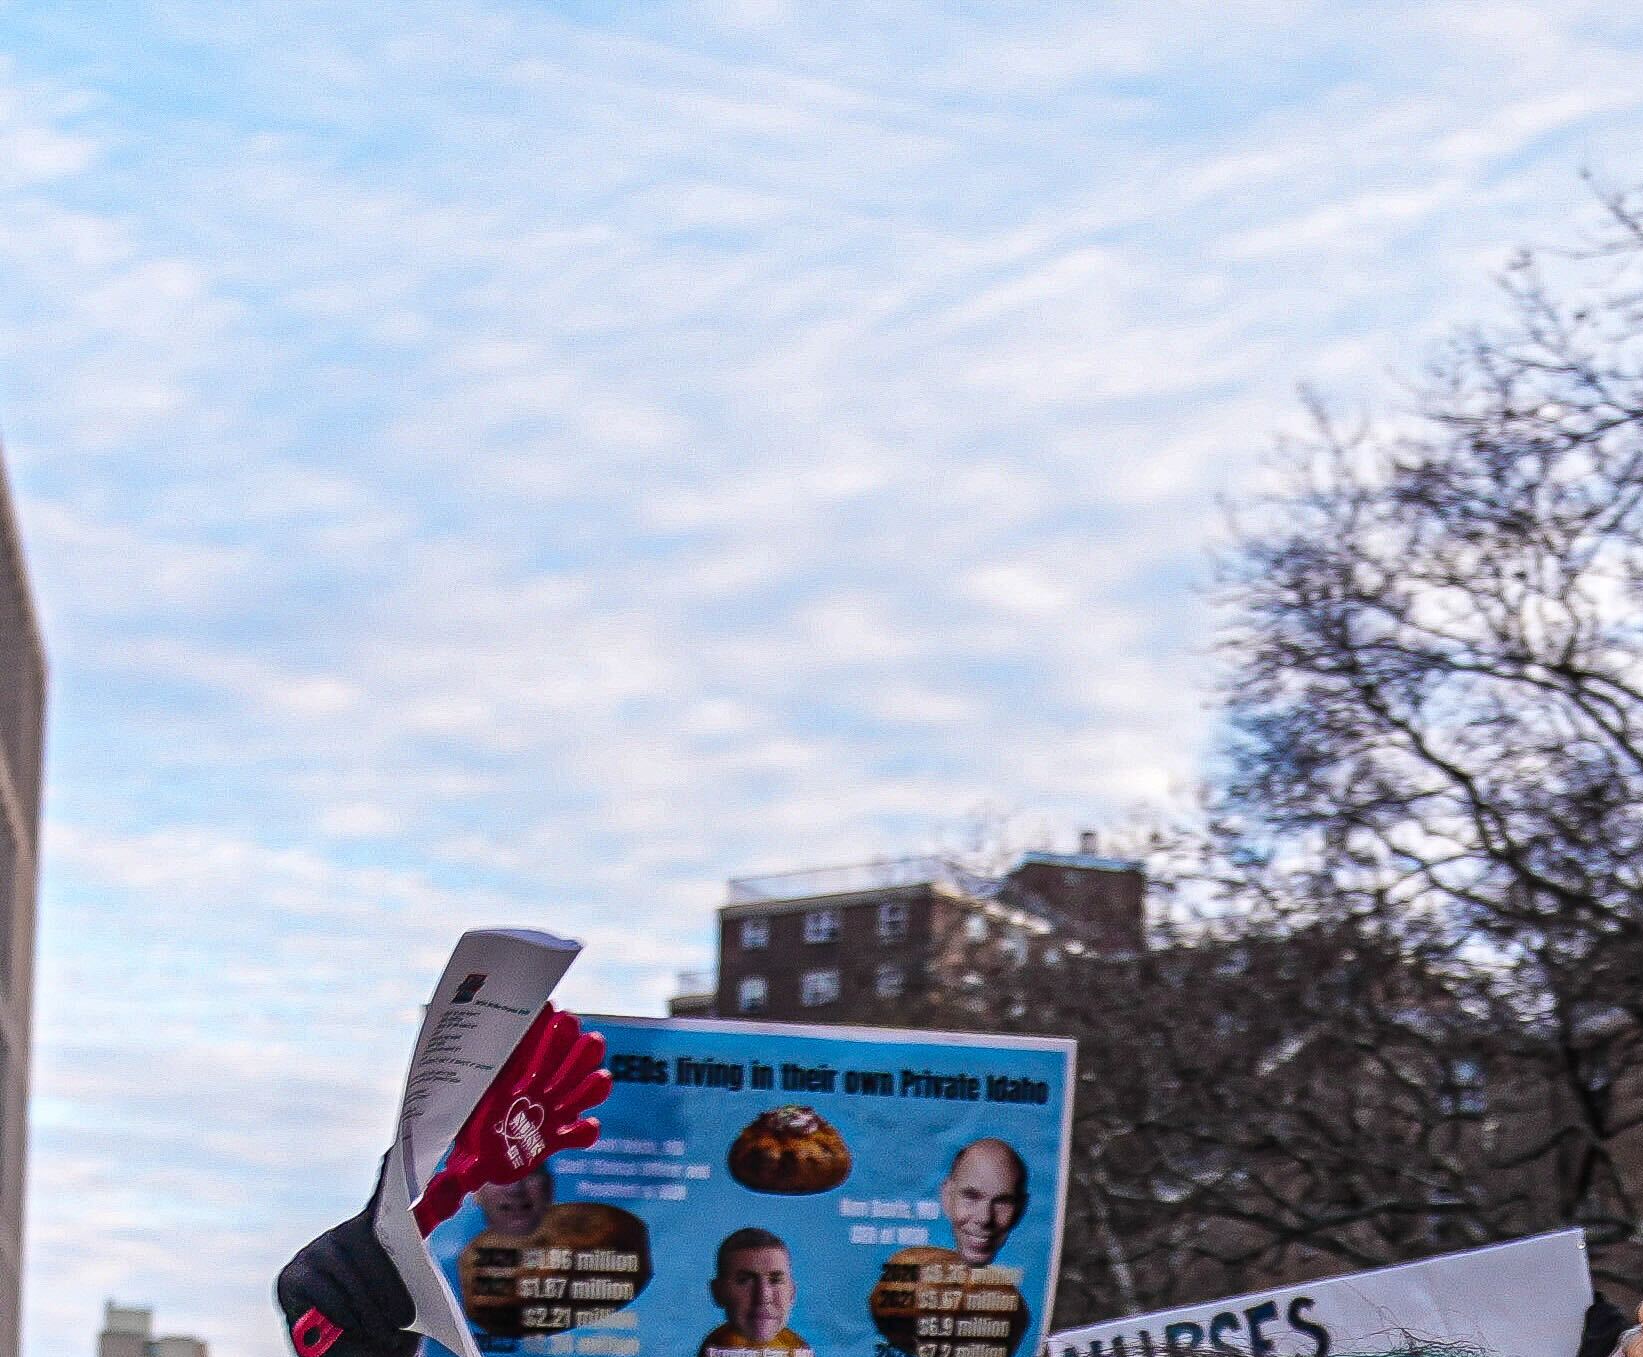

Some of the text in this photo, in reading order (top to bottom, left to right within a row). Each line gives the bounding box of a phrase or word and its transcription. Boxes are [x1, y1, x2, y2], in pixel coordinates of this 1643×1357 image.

[677, 1056, 744, 1091] living
[752, 1060, 774, 1091] in
[781, 1062, 837, 1093] their
[844, 1069, 894, 1096] own
[901, 1068, 981, 1100] Private
[986, 1074, 1048, 1105] Idaho
